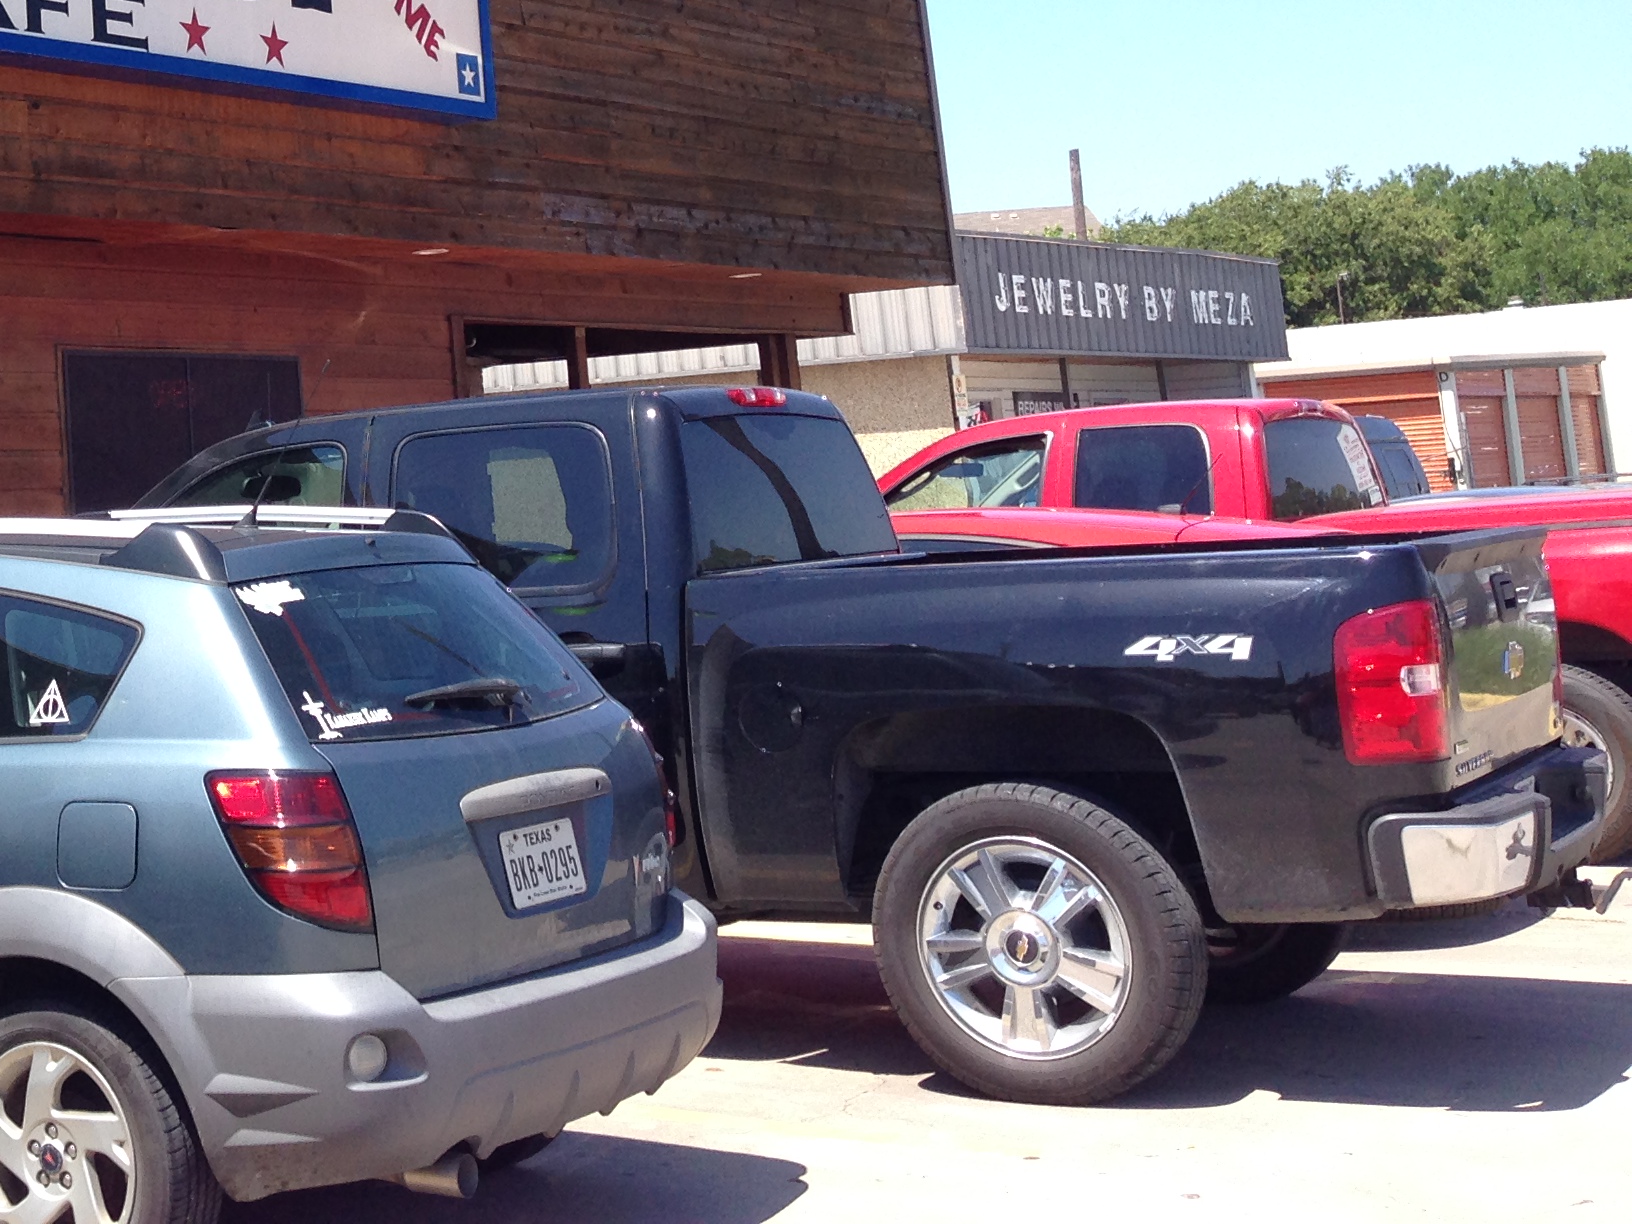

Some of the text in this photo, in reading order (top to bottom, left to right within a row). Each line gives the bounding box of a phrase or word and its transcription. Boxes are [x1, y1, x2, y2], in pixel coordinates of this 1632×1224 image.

[995, 272, 1255, 327] JEWELRY BY MEZA
[523, 828, 552, 847] TEXAS
